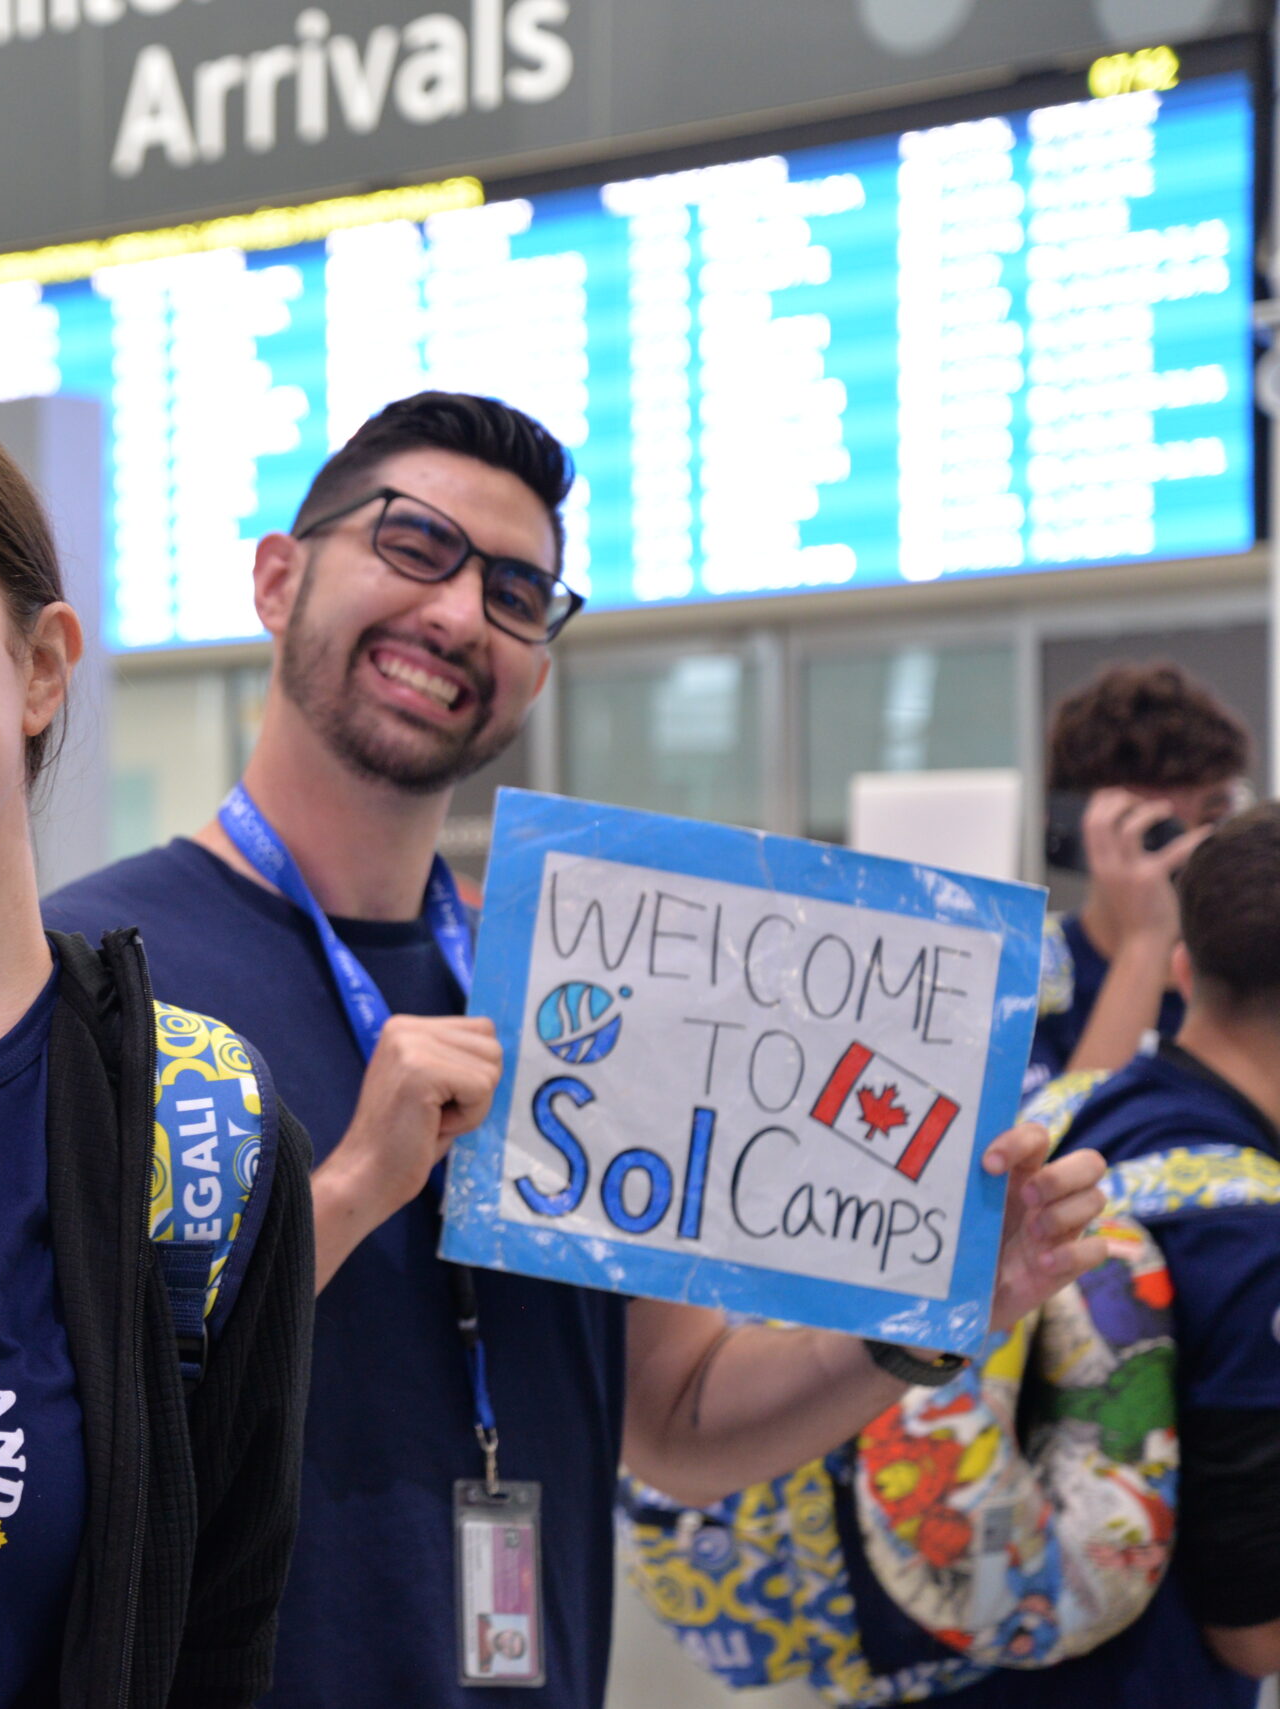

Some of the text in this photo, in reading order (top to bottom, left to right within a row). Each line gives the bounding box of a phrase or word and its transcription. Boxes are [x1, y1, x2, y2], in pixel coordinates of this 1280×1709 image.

[111, 0, 573, 177] Arrivals
[683, 1017, 805, 1114] TO
[175, 1096, 223, 1242] EGALI
[514, 1075, 947, 1272] Sol Camps
